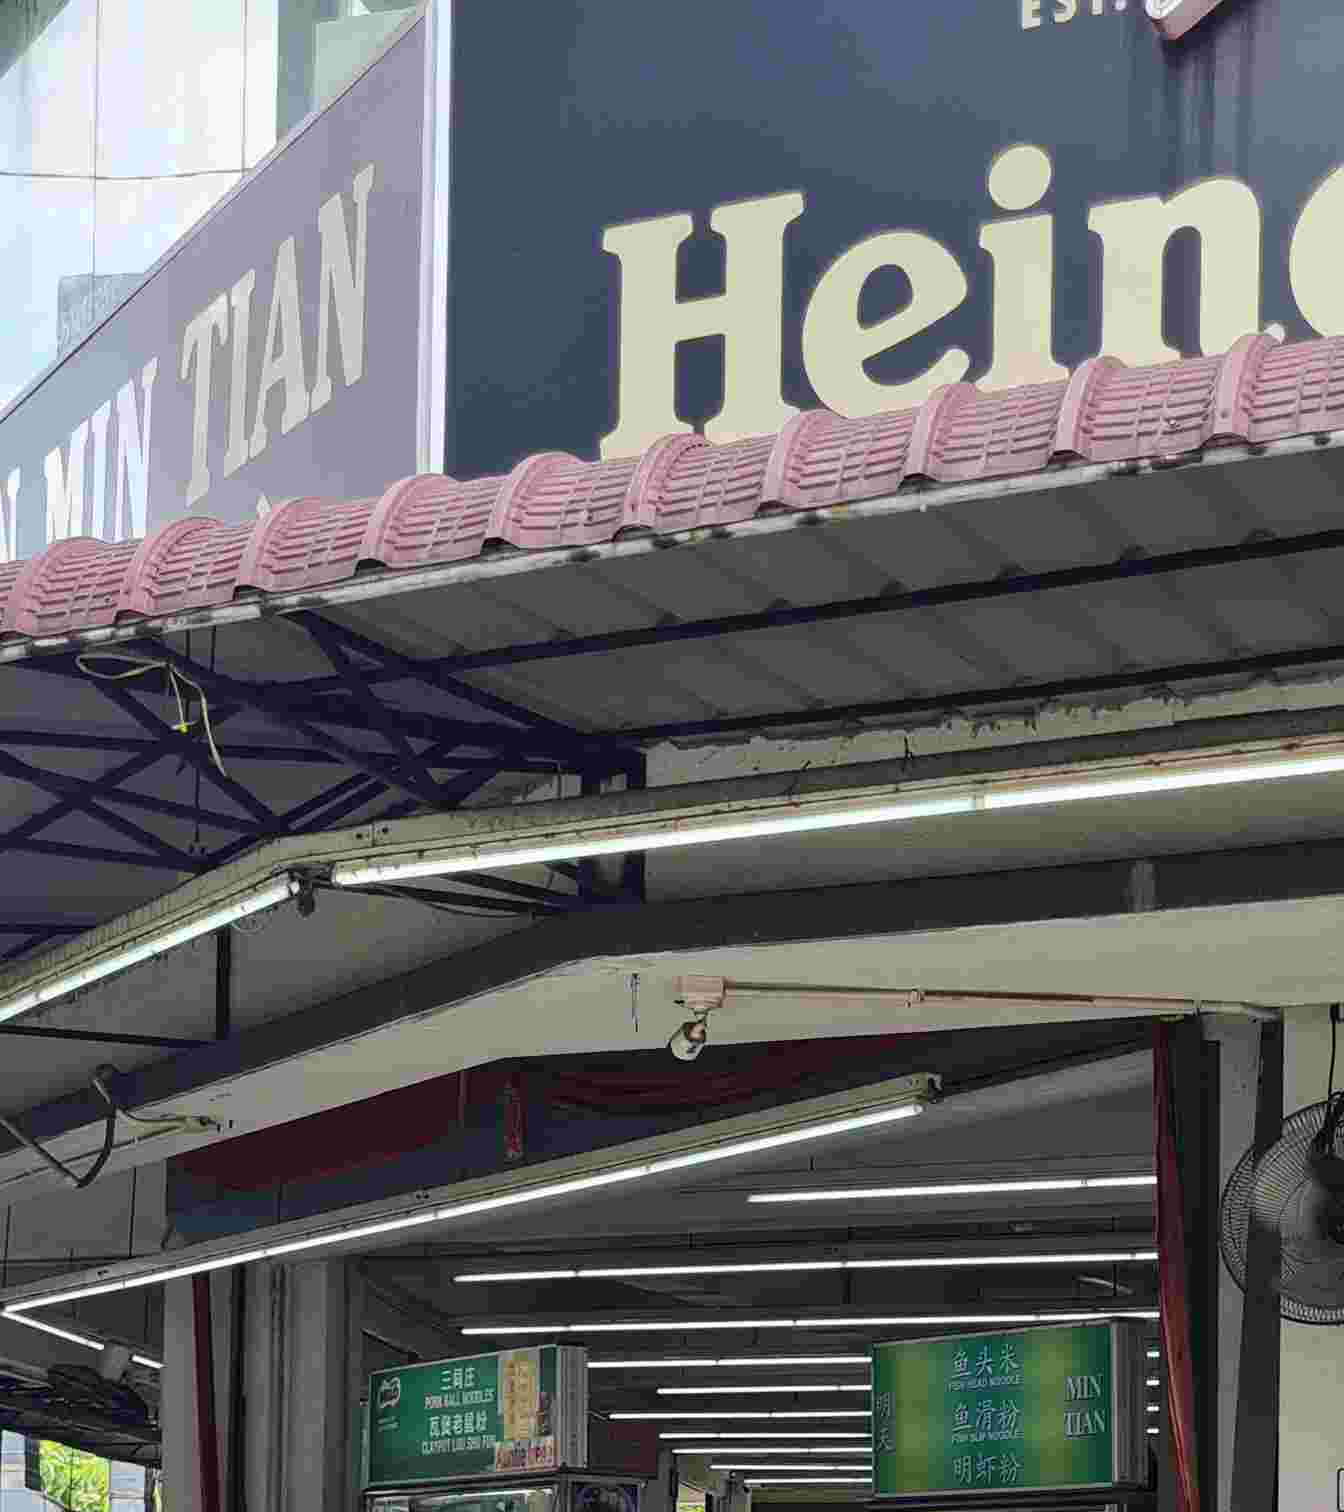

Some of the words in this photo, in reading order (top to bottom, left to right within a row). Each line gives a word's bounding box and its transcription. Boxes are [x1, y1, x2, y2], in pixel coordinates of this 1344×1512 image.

[180, 164, 374, 507] TIAN
[1065, 1375, 1102, 1400] MIN
[1064, 1408, 1105, 1436] TIAN
